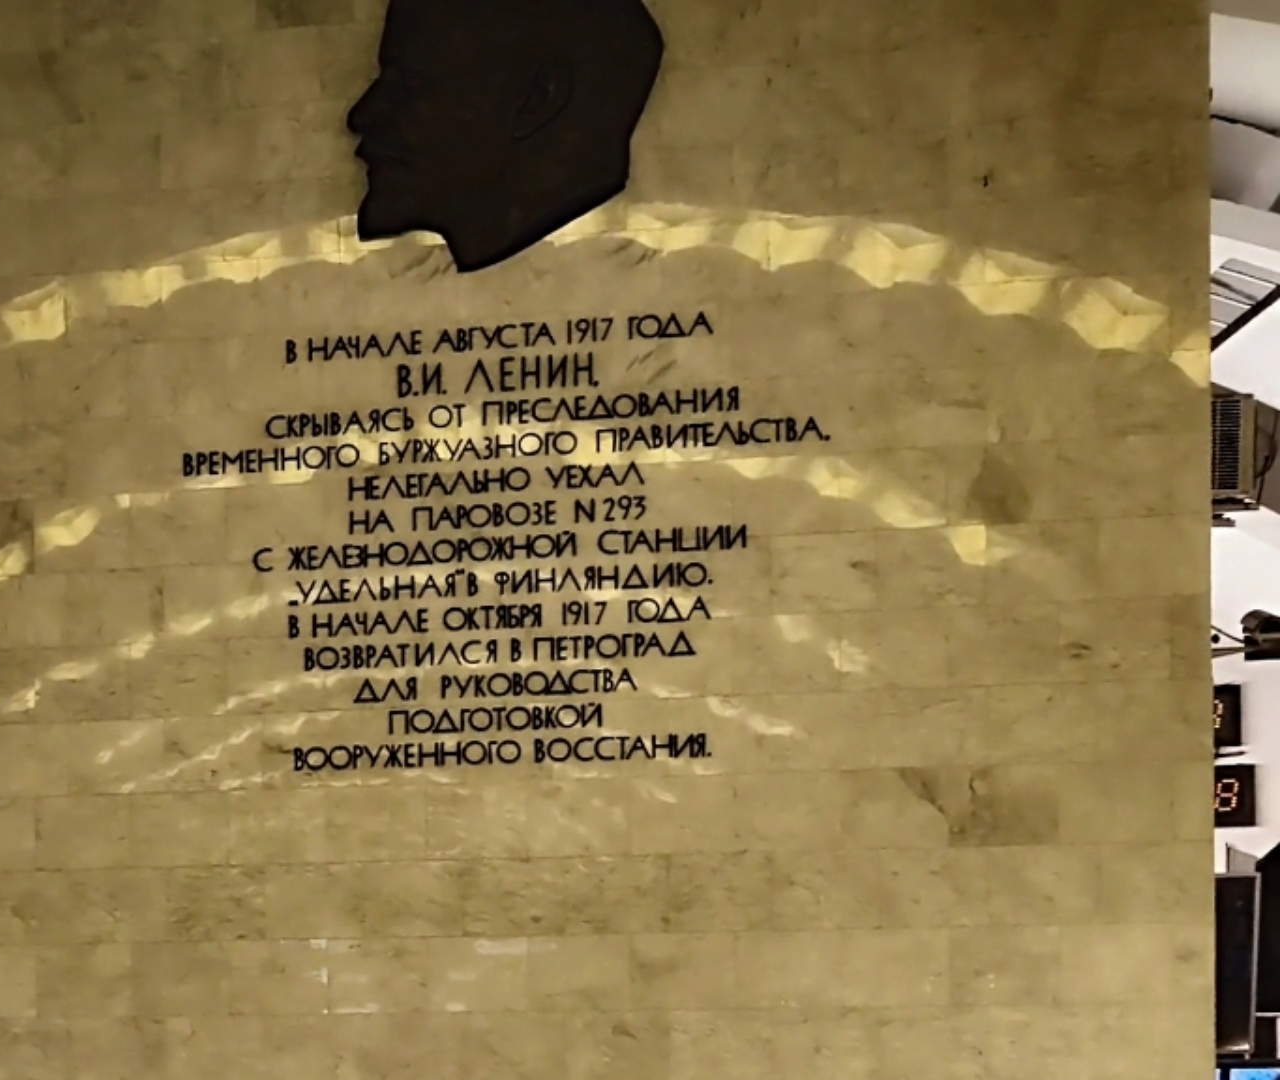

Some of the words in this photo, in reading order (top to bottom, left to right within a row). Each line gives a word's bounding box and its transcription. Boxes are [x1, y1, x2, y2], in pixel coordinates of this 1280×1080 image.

[285, 339, 298, 365] В
[307, 329, 422, 363] НАЧАЛЕ
[431, 322, 557, 354] АВГУСТА
[566, 317, 614, 345] 1917
[627, 311, 714, 340] ГОДА
[396, 362, 447, 399] В.И.
[264, 406, 415, 440] СКРЫВАЯСЬ
[428, 403, 466, 429] ОТ
[481, 385, 740, 427] ПРЕСЛЕДОВАНИЯ
[182, 443, 361, 477] ВРЕМЕННОГО
[378, 430, 578, 467] БУРЖУАЗНОГО
[347, 466, 531, 502] НЕЛЕГАЛЬНО
[544, 460, 645, 490] УЕХАЛ
[348, 509, 395, 535] НА
[411, 500, 557, 532] ПАРОВОЗЕ
[602, 494, 647, 522] 293
[251, 547, 274, 573] С
[287, 530, 578, 571] ЖЕЛЕЗНОДОРОЖНОЙ
[596, 524, 748, 556] СТАНЦИИ
[465, 571, 479, 598] В
[494, 561, 714, 596] ФИНЛЯНДИЮ.
[287, 614, 300, 640] В
[311, 608, 429, 639] НАЧАЛЕ
[442, 603, 543, 632] ОКТЯБРЯ
[561, 600, 608, 626] 1917
[627, 595, 712, 624] ГОДА
[303, 638, 498, 672] ВОЗВРАТИЛСЯ
[510, 637, 522, 663] В
[532, 630, 697, 662] ПЕТРОГРАД
[353, 676, 418, 704] ДЛЯ
[440, 667, 638, 700] РУКОВОДСТВА
[388, 702, 603, 736] ПОДГОТОВКОЙ
[292, 739, 522, 773] ВООРУЖЕННОГО
[533, 732, 712, 764] ВОССТАНИЯ.
